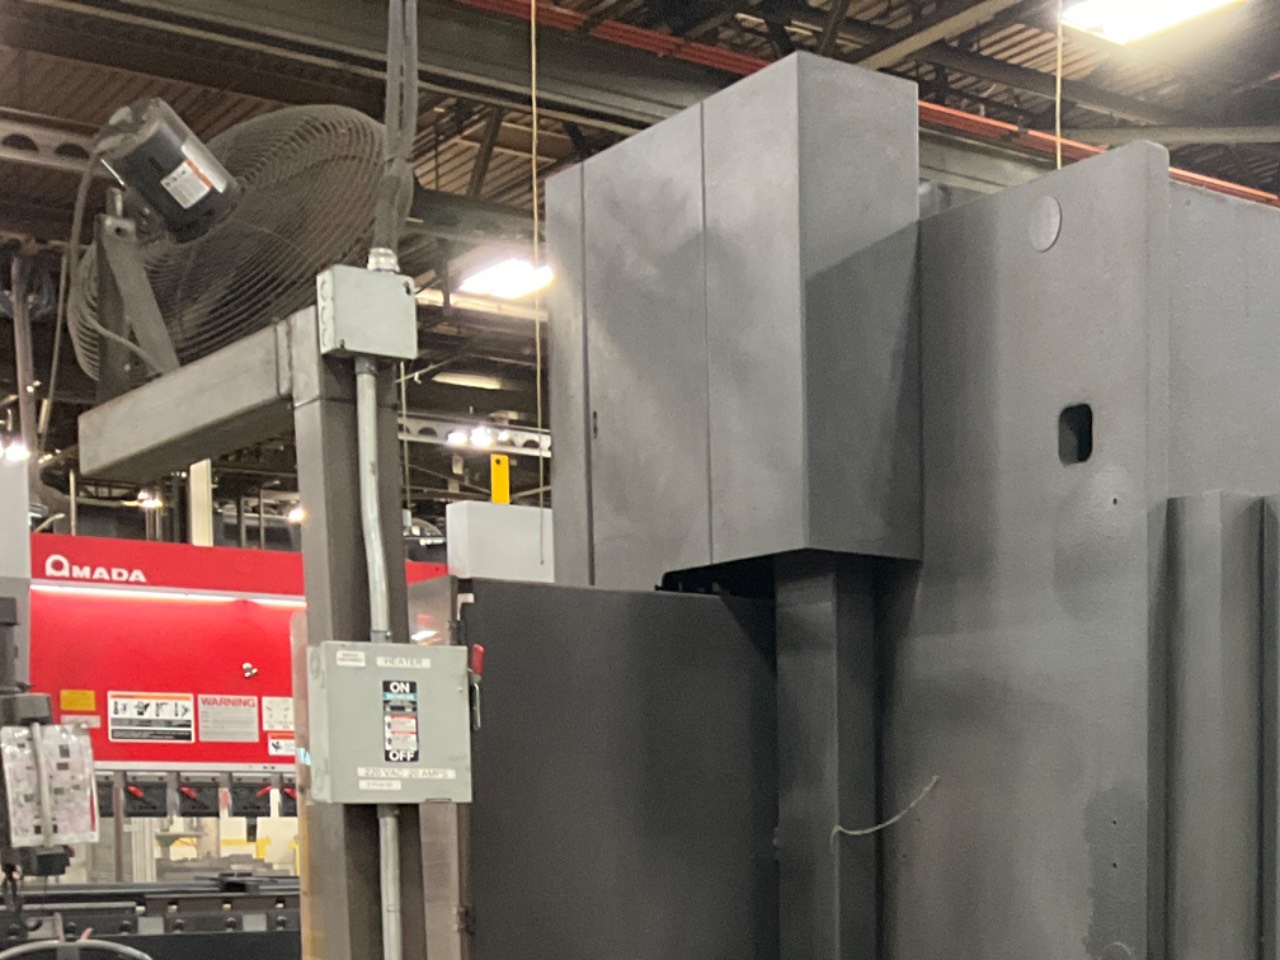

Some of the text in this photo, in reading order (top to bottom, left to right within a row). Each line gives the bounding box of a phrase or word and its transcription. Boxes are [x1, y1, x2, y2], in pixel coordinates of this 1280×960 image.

[45, 554, 147, 583] AMADA
[389, 682, 410, 693] ON
[201, 696, 256, 708] WARNING
[389, 751, 414, 762] OFF
